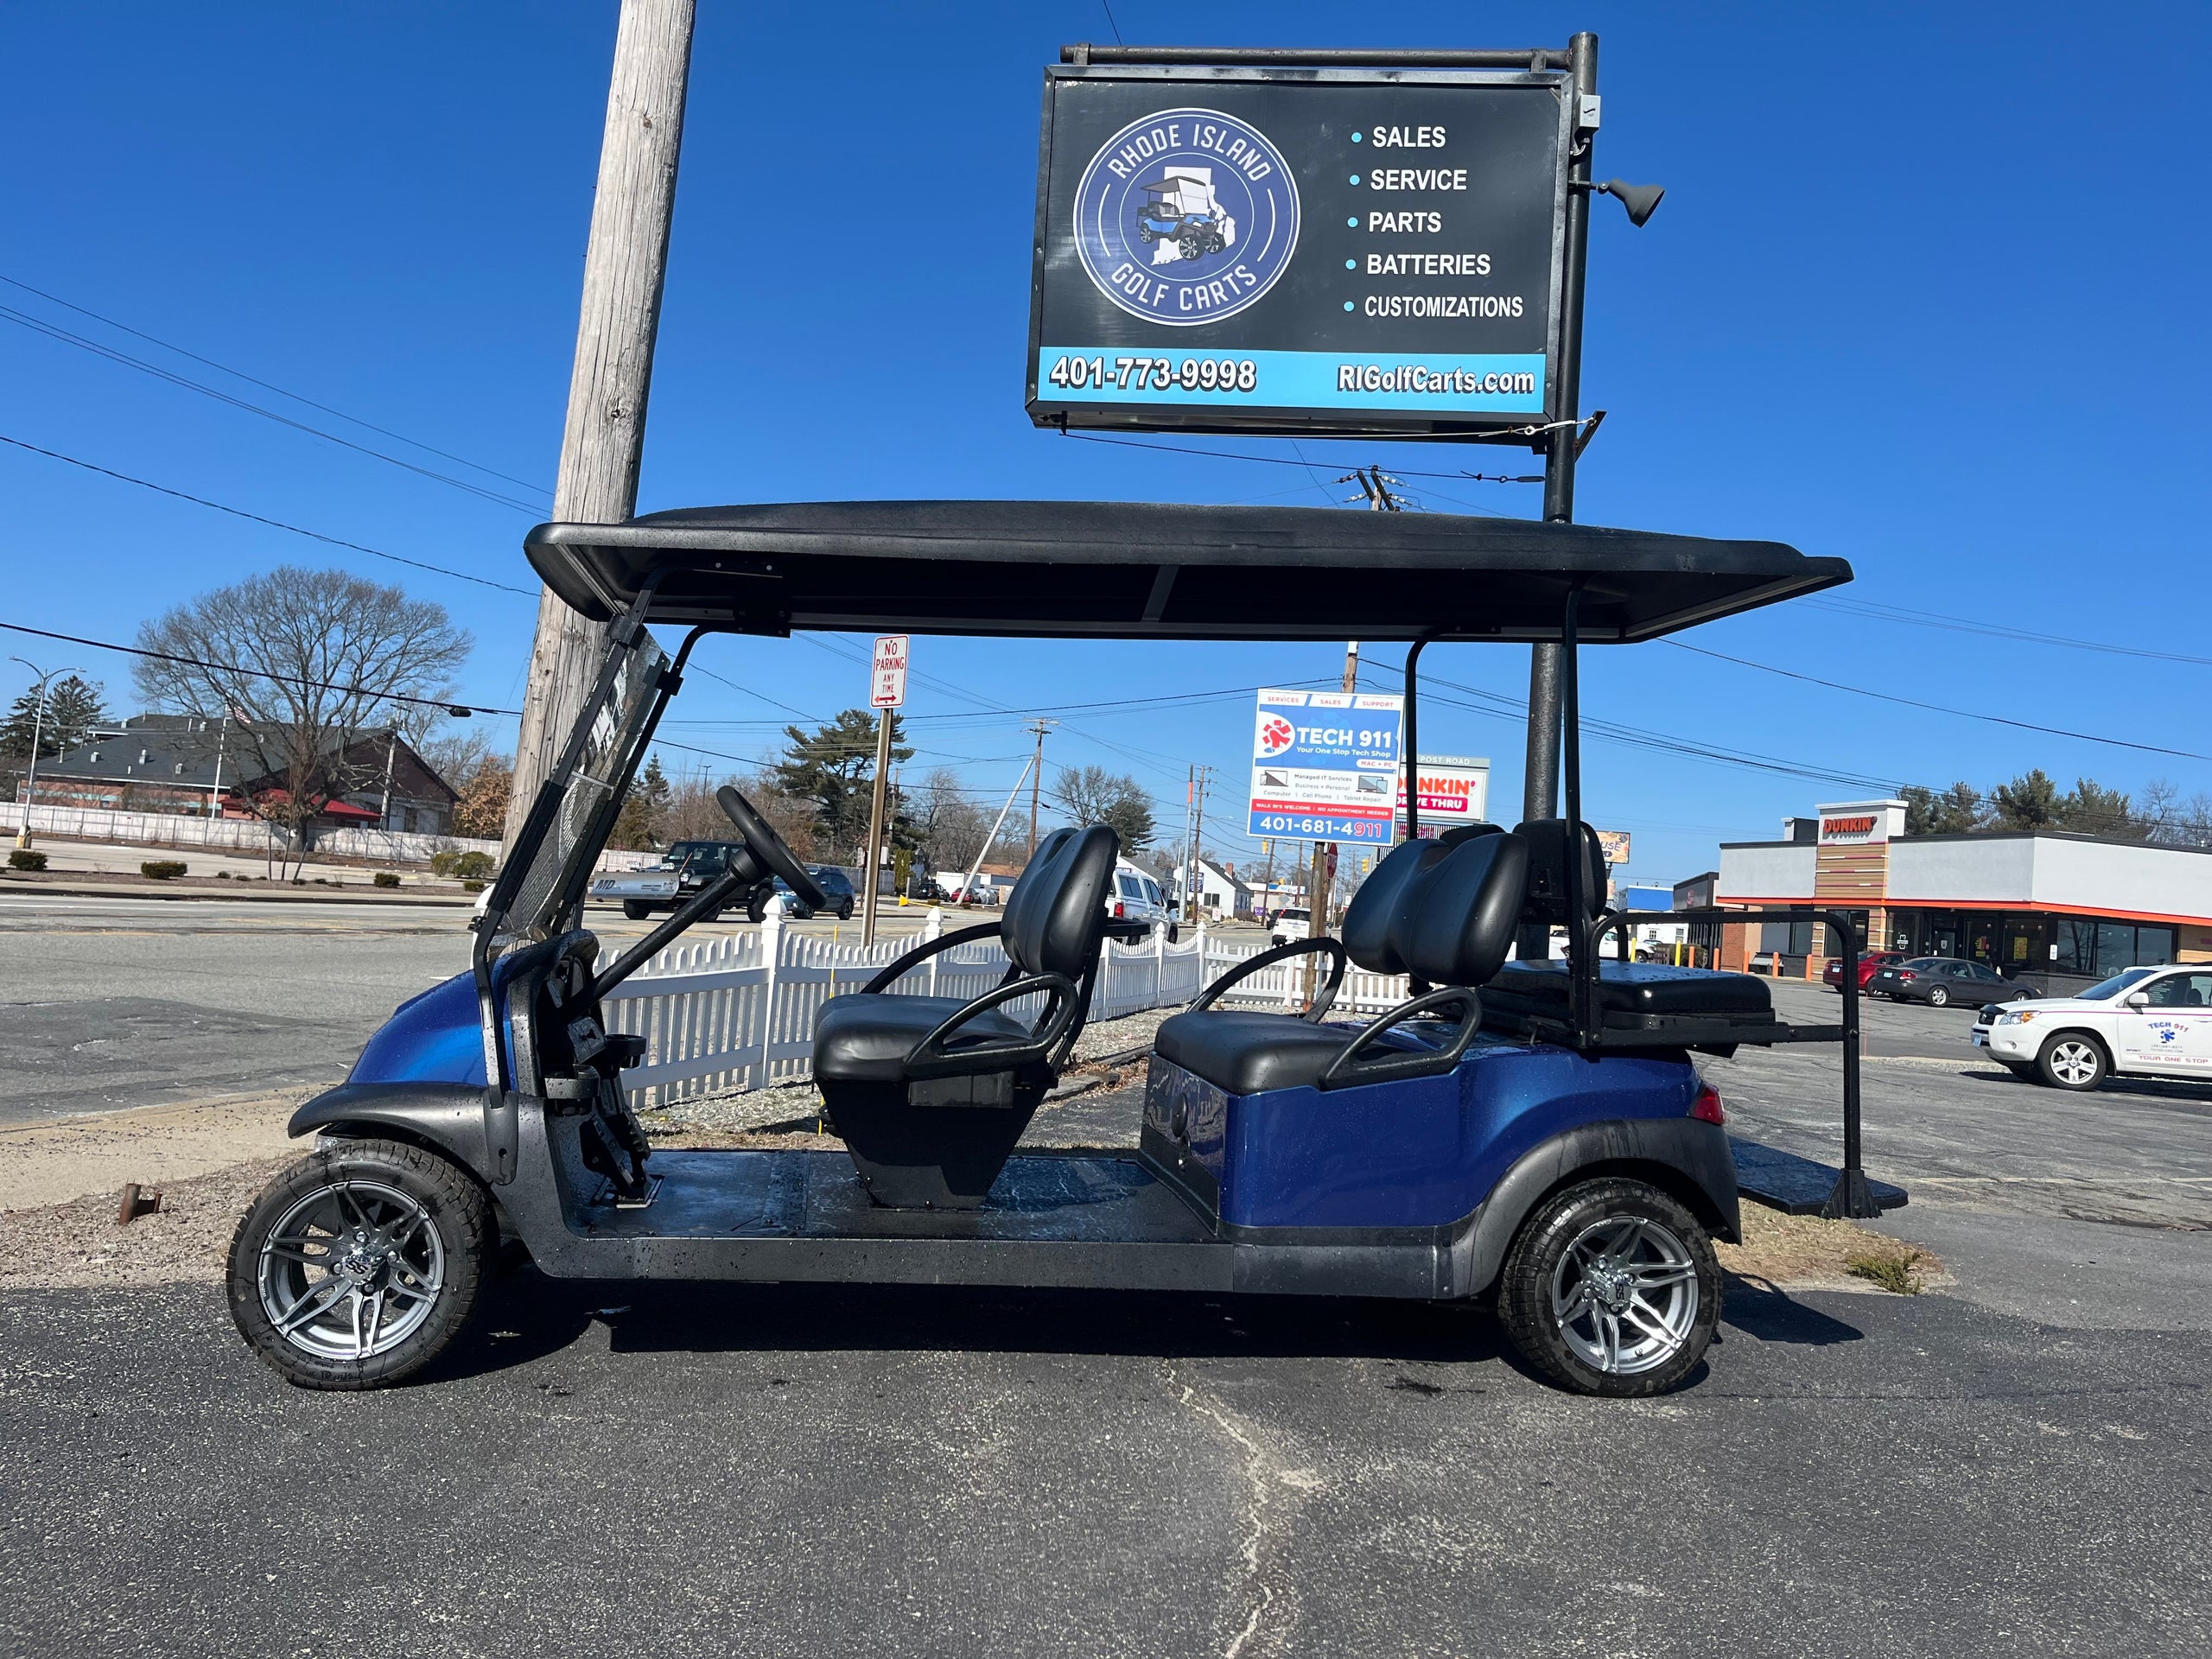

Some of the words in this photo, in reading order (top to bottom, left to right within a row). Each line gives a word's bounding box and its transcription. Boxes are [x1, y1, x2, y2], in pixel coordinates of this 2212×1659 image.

[1372, 126, 1446, 148] SALES
[1107, 124, 1182, 179] RHODE
[1192, 124, 1271, 181] ISLAND
[1370, 169, 1467, 190] SERVICE
[1369, 212, 1442, 233] PARTS
[1367, 254, 1491, 276] BATTERIES
[1111, 263, 1169, 307] GOLF
[1179, 264, 1256, 311] CARTS
[1364, 296, 1524, 318] CUSTOMIZATIONS
[1049, 355, 1257, 392] 401-773-9998
[1338, 364, 1535, 395] RIGolfCarts.com
[885, 642, 898, 656] NO
[875, 657, 905, 671] PARKING
[882, 683, 894, 693] TIME
[883, 673, 895, 683] ANY
[1296, 727, 1354, 747] TECH
[1359, 730, 1391, 748] 911
[1371, 750, 1391, 759] Shop
[1431, 798, 1463, 809] THRU
[1260, 816, 1382, 838] 401-681-4911
[2174, 1023, 2190, 1033] 911
